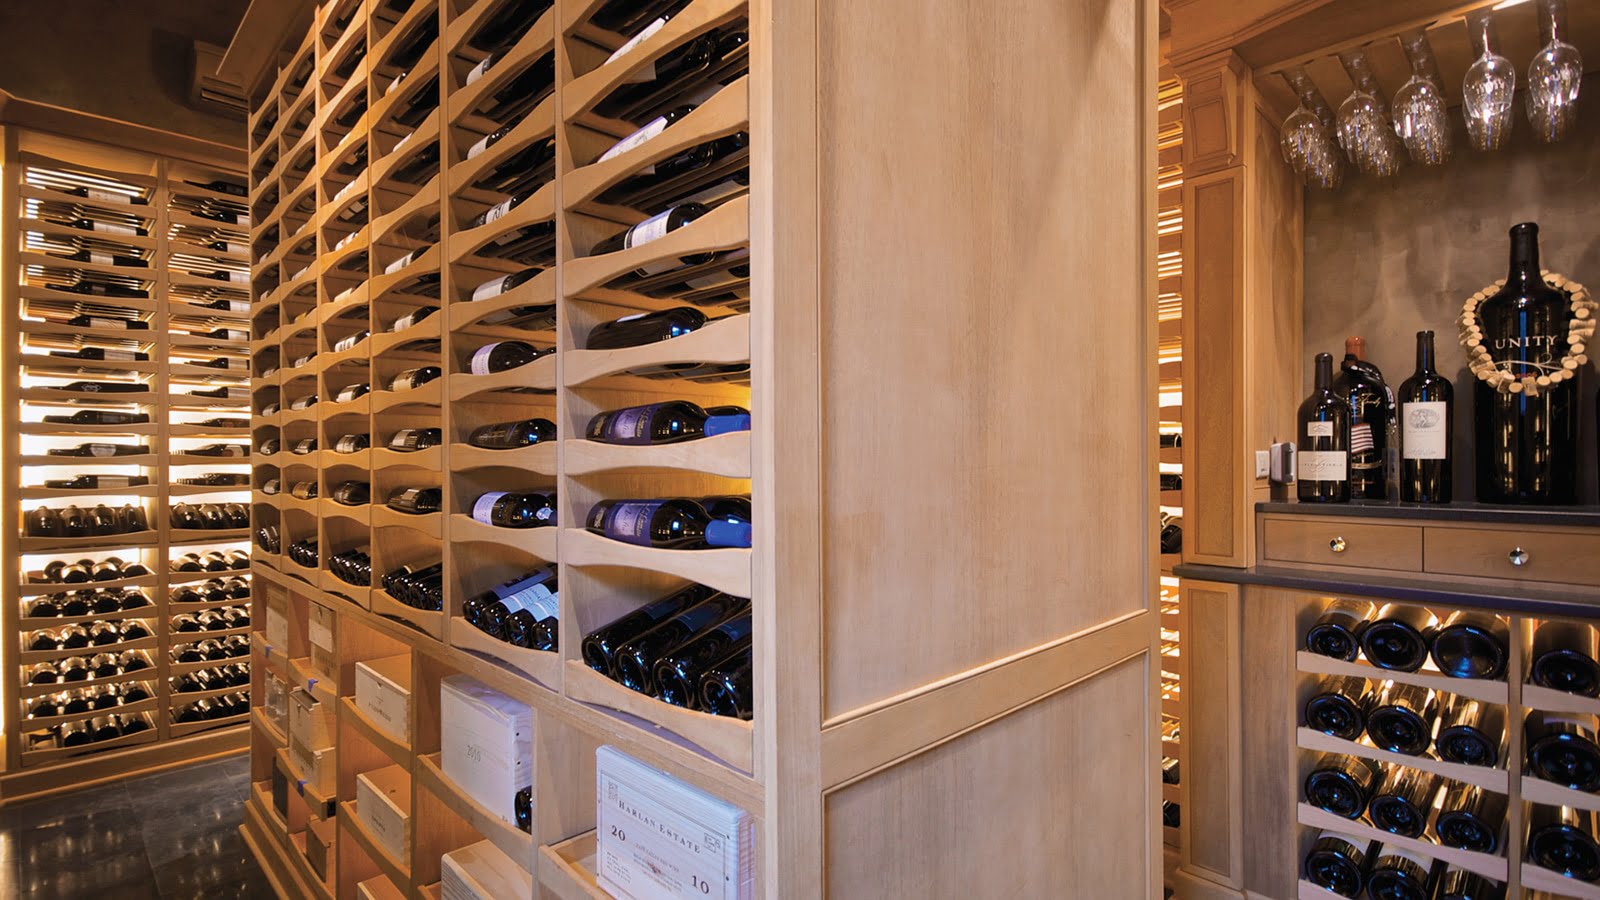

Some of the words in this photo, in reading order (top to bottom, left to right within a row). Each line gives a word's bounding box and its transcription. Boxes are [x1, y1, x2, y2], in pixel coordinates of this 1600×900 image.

[1495, 334, 1558, 350] UNITY
[611, 825, 626, 842] 20
[618, 800, 656, 828] HARLAN
[659, 824, 700, 854] ESTATE
[691, 875, 710, 895] 10
